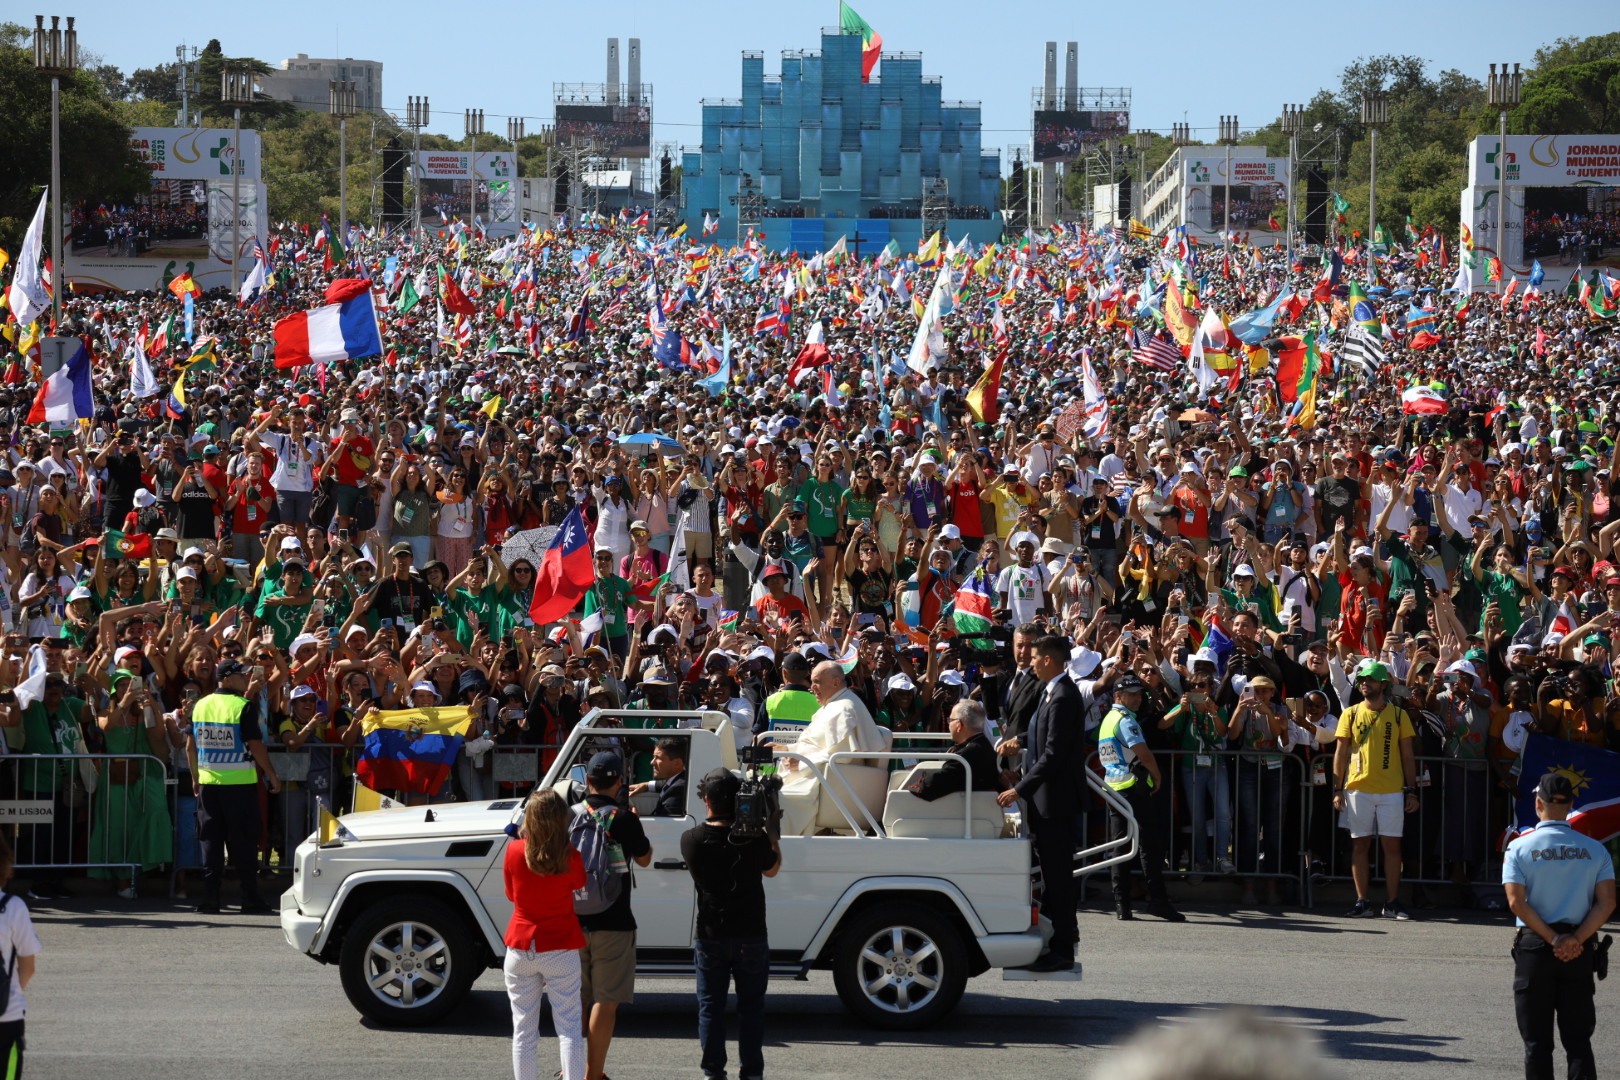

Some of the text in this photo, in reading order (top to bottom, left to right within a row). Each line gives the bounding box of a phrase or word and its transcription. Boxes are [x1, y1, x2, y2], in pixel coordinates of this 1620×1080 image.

[157, 139, 165, 161] 2023
[1566, 145, 1620, 156] JORNAD
[1566, 156, 1620, 167] MUNDIA
[1506, 164, 1520, 172] JMJ
[1577, 168, 1620, 177] JUVENT
[1492, 221, 1521, 229] LIBOA
[182, 490, 209, 498] adidas
[1382, 721, 1392, 770] VOLUNTÁRIO
[8, 807, 16, 816] M
[19, 807, 53, 816] LISBOA
[1531, 845, 1592, 862] POLÍCIA
